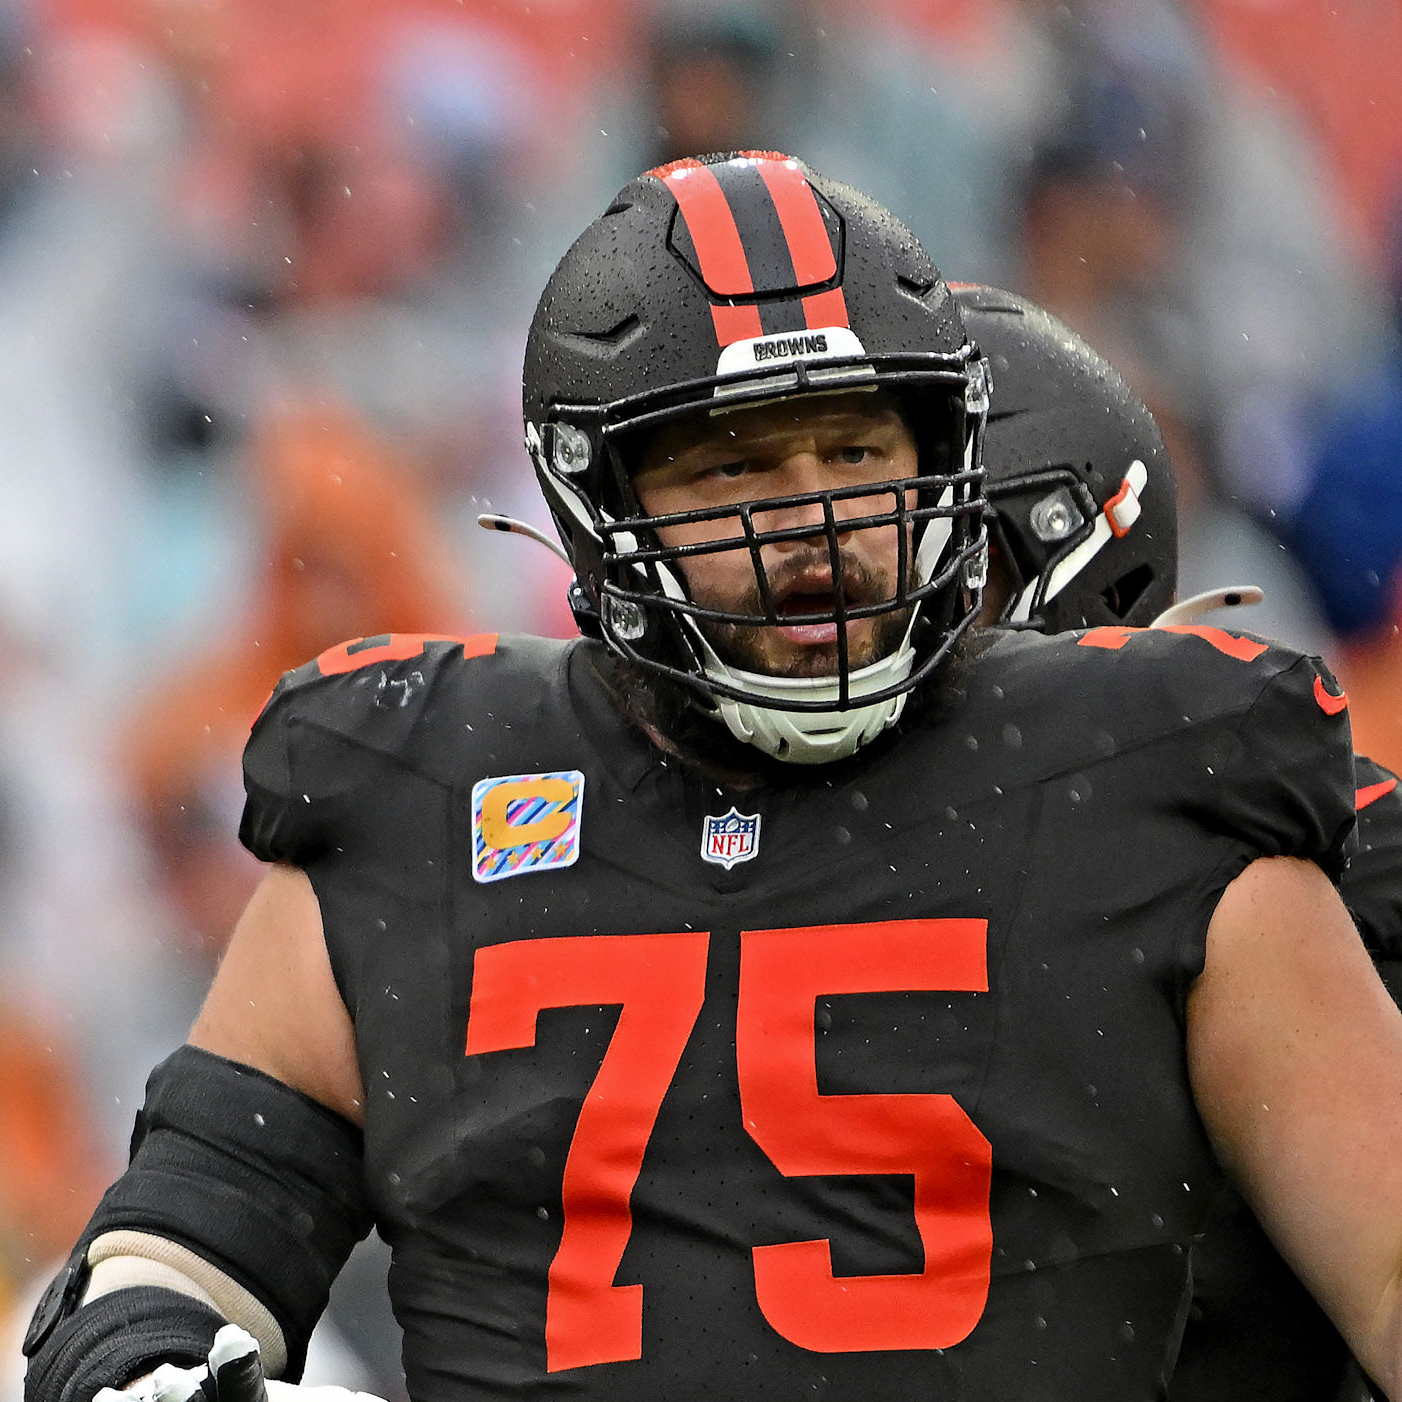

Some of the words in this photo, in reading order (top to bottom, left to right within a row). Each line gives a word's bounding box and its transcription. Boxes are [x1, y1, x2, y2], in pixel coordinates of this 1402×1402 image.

[753, 334, 828, 361] BROWNS
[482, 778, 574, 850] C
[711, 833, 750, 856] NFL
[465, 917, 993, 1373] 75
